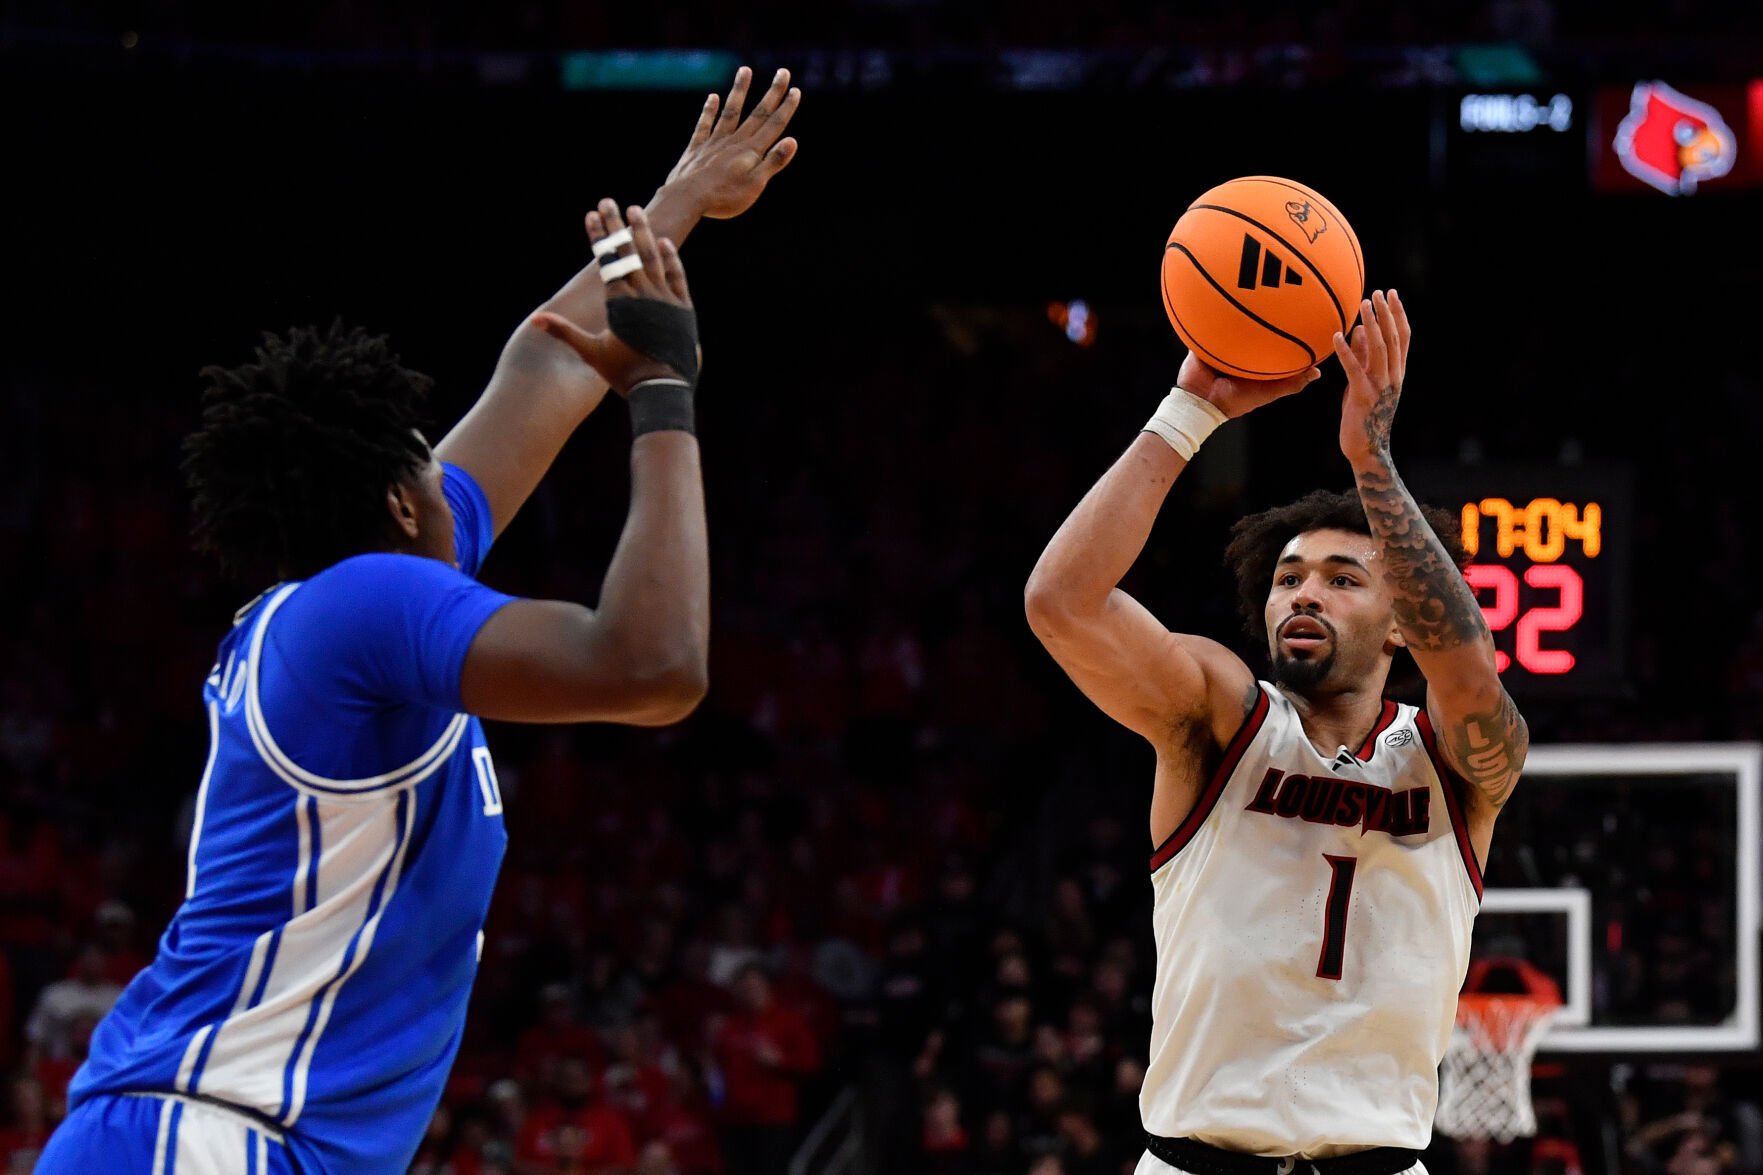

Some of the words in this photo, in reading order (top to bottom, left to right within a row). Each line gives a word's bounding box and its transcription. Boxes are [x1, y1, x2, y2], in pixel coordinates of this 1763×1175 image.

[1461, 497, 1601, 562] 17:04
[1463, 564, 1583, 674] 22
[1244, 767, 1430, 837] LOUISVILE
[1315, 853, 1357, 980] 1
